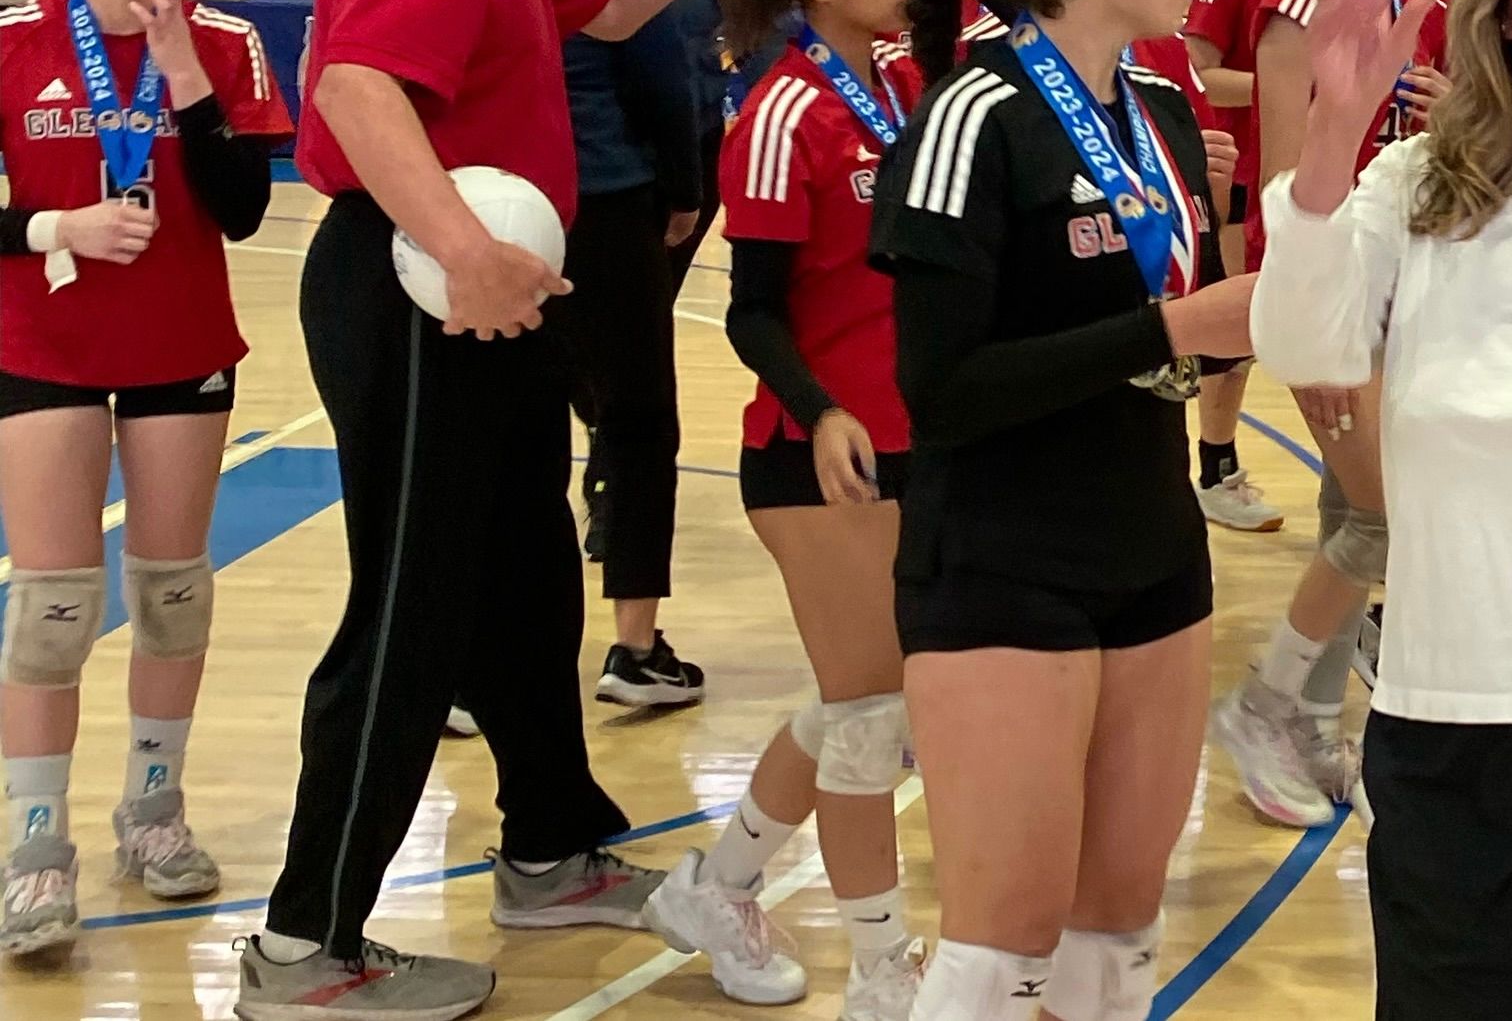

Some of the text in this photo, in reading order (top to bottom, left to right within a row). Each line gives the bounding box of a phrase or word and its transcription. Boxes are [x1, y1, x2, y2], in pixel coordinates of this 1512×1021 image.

[72, 4, 112, 102] 2023-2024
[832, 71, 897, 145] 2023-20
[1032, 58, 1121, 183] 2023-2024
